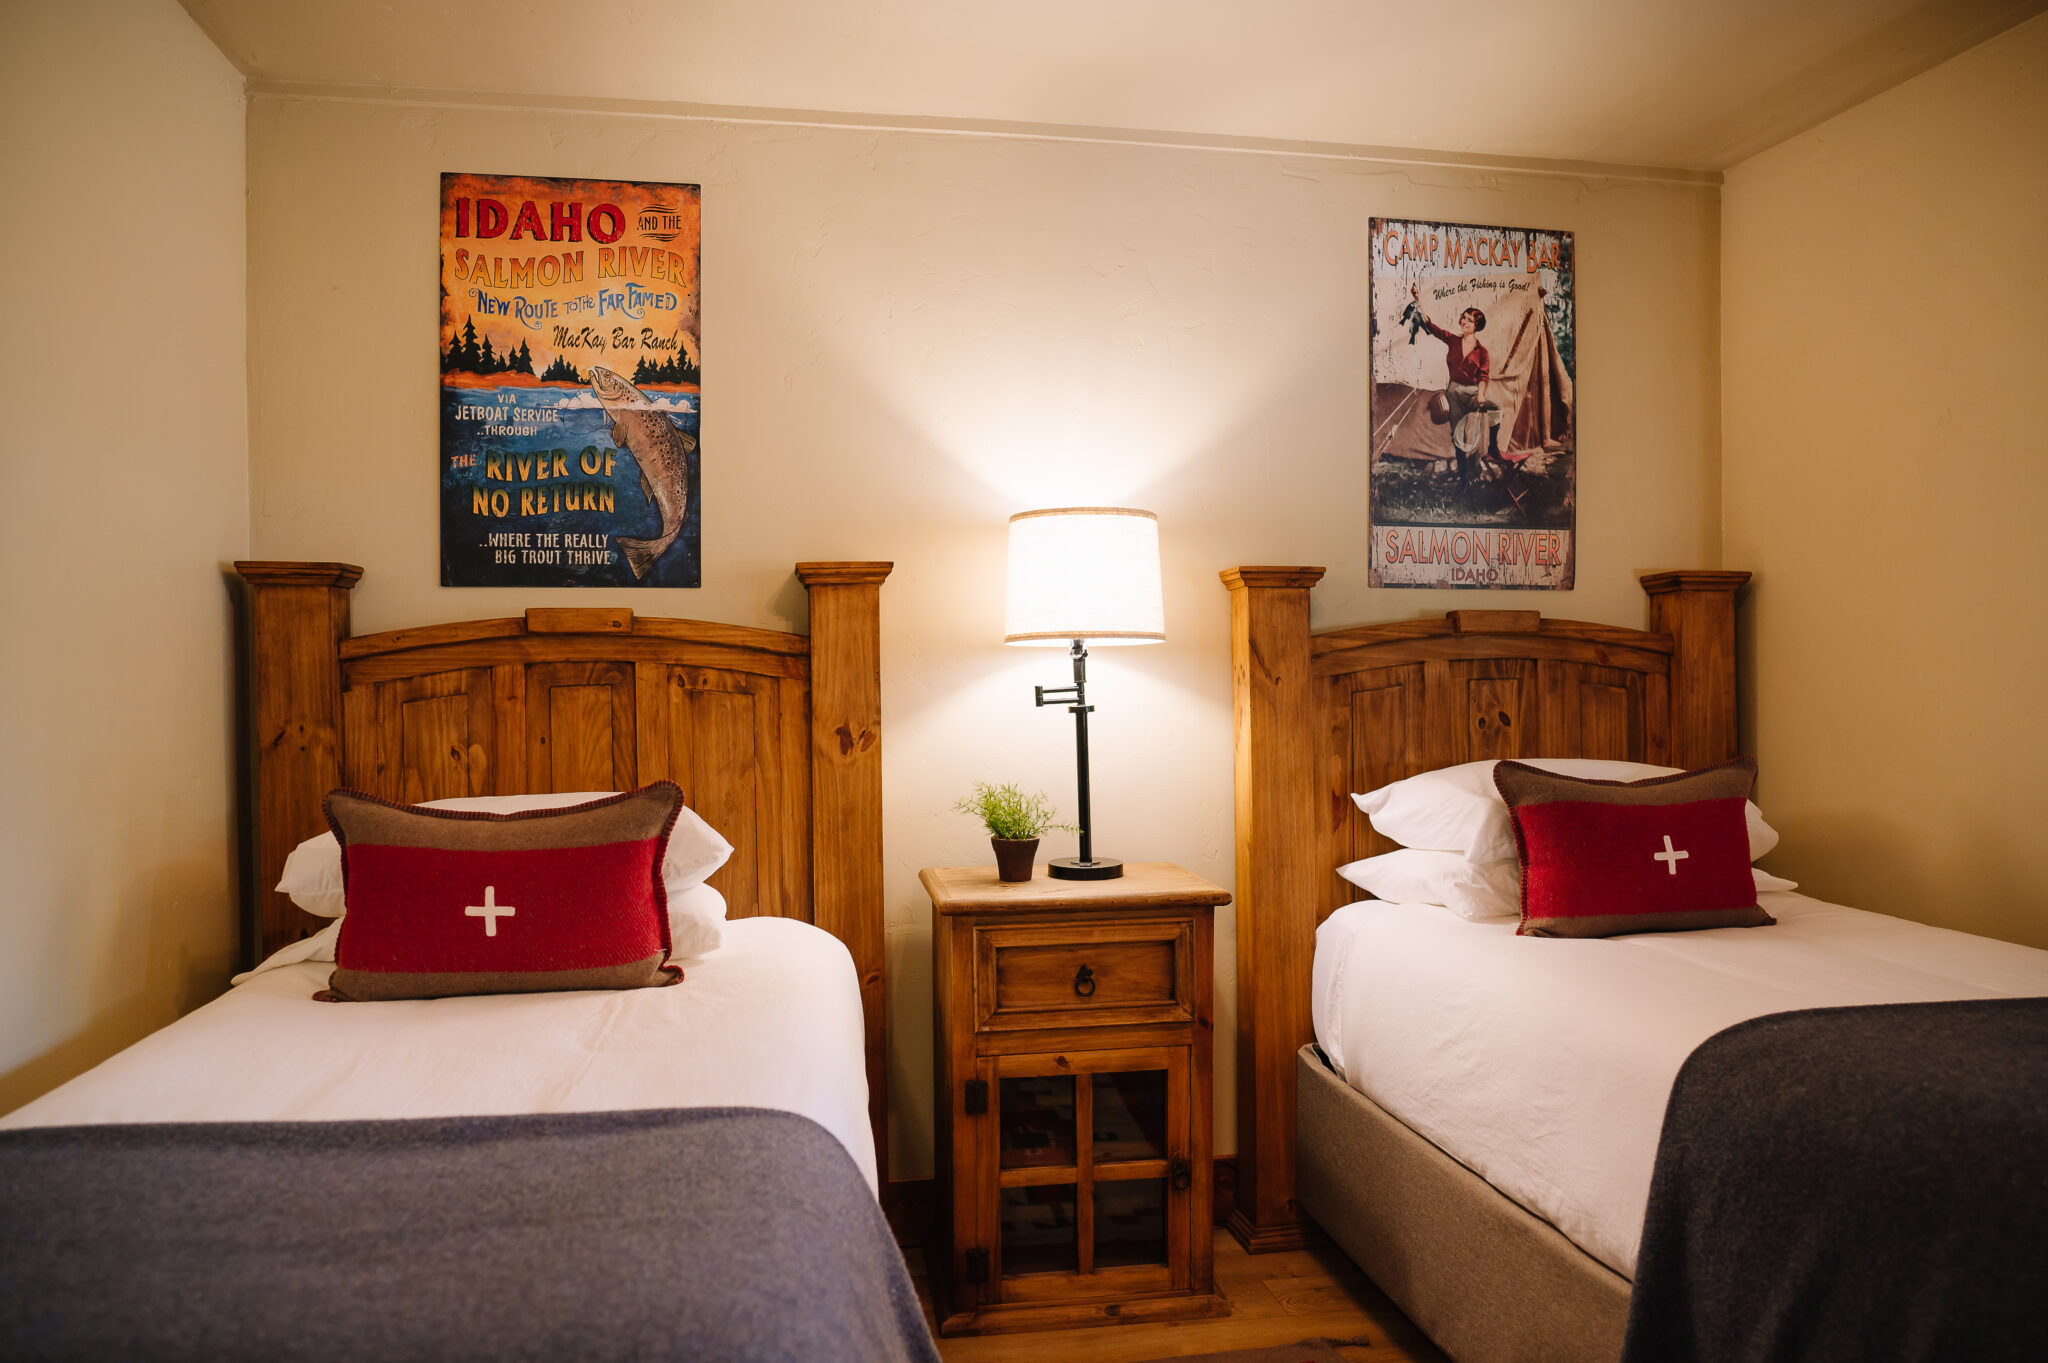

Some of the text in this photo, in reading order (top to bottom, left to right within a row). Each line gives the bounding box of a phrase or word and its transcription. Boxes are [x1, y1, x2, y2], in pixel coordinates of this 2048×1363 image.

[455, 197, 626, 244] IDAHO
[637, 215, 682, 231] AND THE
[1384, 229, 1561, 273] CAMP MACKAY BAR
[454, 246, 687, 289] SALMON RIVER
[1432, 277, 1531, 301] Where the Fishing is Good!
[468, 287, 510, 317] NEW
[514, 296, 558, 330] ROUTE
[625, 282, 678, 311] FAMED
[553, 325, 679, 355] MacKay Bar Ranch
[455, 405, 558, 423] JETBOAT SERVICE
[497, 393, 517, 405] VIA
[450, 445, 618, 482] THE RIVER OF
[472, 482, 615, 518] NO RETURN
[536, 533, 560, 548] THE
[564, 534, 609, 549] REALLY
[1385, 528, 1561, 566] SALMON RIVER
[495, 550, 612, 566] BIG TROUT THRIVE
[1451, 567, 1499, 582] IDAHO
